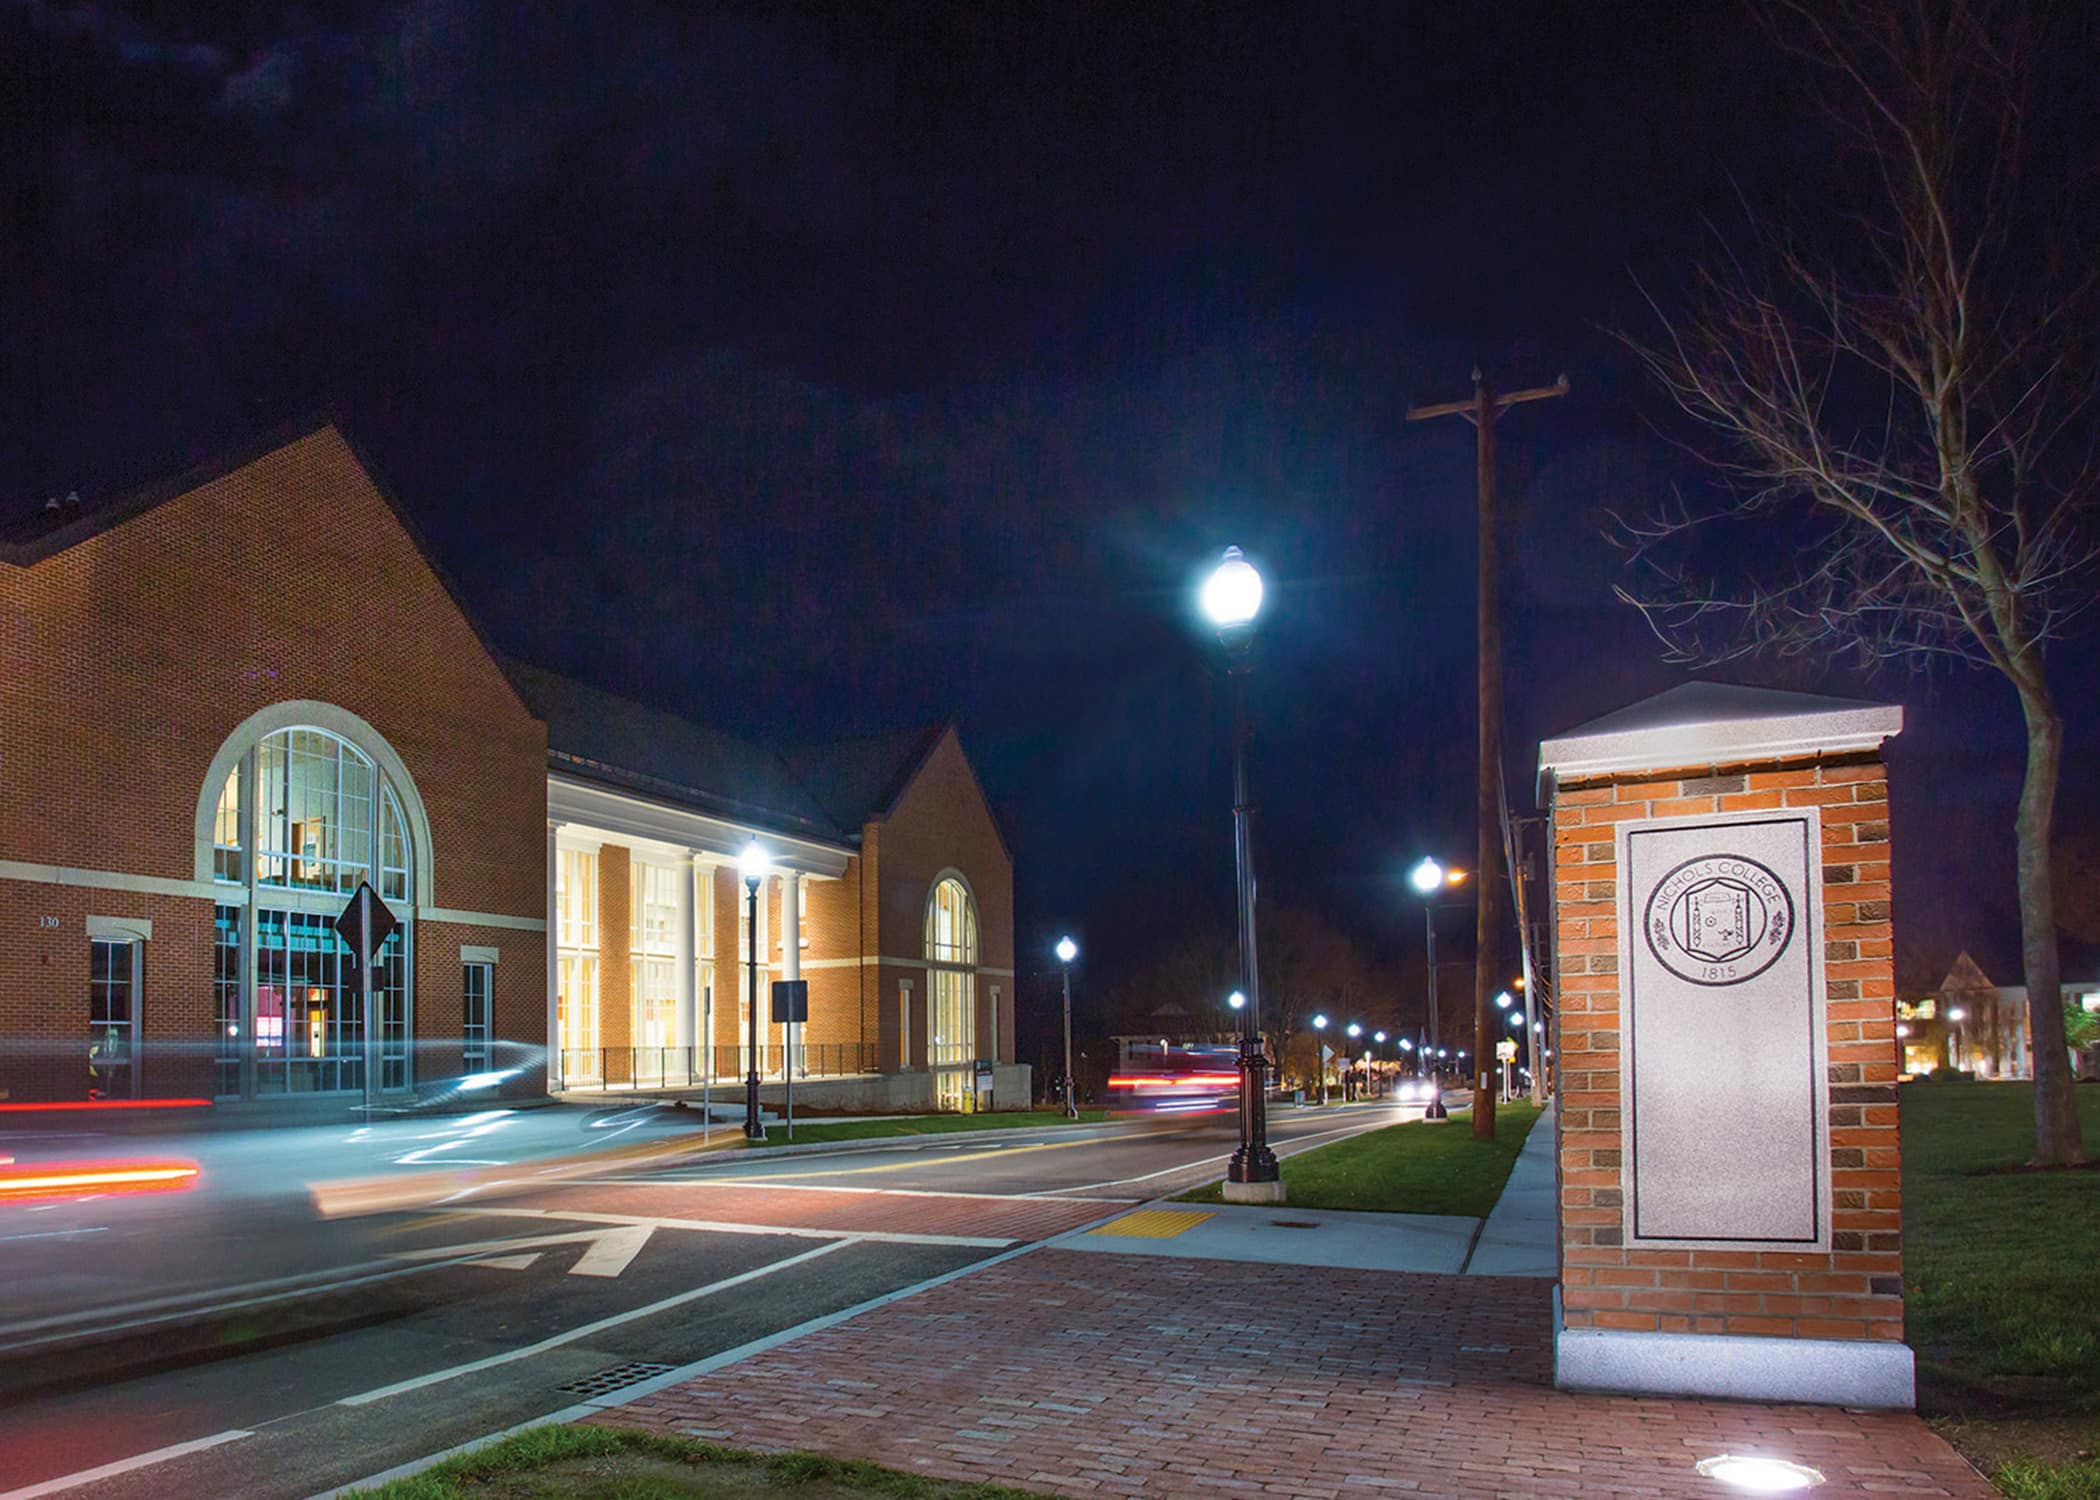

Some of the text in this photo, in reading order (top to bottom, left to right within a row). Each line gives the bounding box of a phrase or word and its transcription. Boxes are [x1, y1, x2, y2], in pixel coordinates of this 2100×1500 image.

[1656, 861, 1781, 911] NICHOLS COLLEGE
[40, 915, 60, 928] 130
[1702, 966, 1737, 979] 1815
